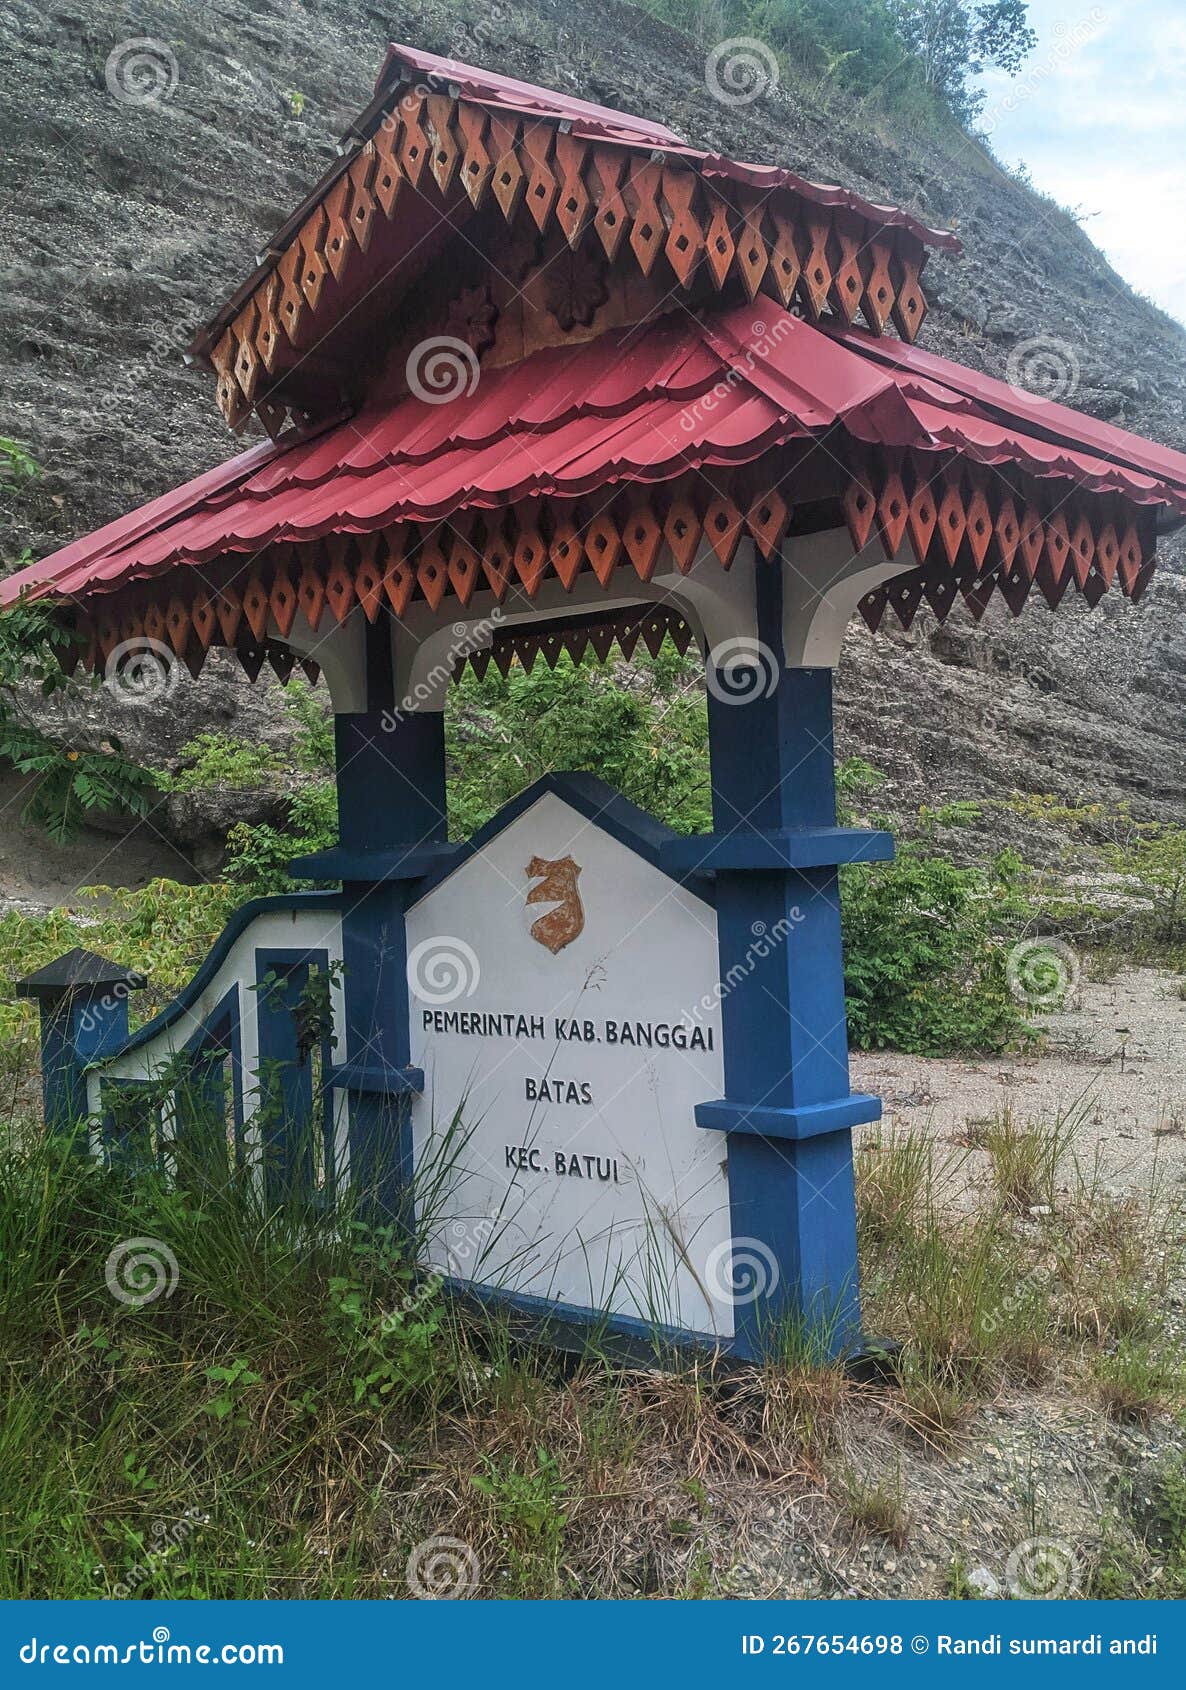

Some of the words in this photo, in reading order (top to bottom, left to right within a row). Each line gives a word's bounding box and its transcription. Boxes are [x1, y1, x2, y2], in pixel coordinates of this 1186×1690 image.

[422, 1010, 546, 1040] PEMERINTAH
[554, 1018, 602, 1044] KAB.
[605, 1020, 715, 1052] BANGGAI
[525, 1078, 593, 1105] BATAS
[505, 1145, 549, 1173] KEC.
[554, 1151, 619, 1183] BATUI
